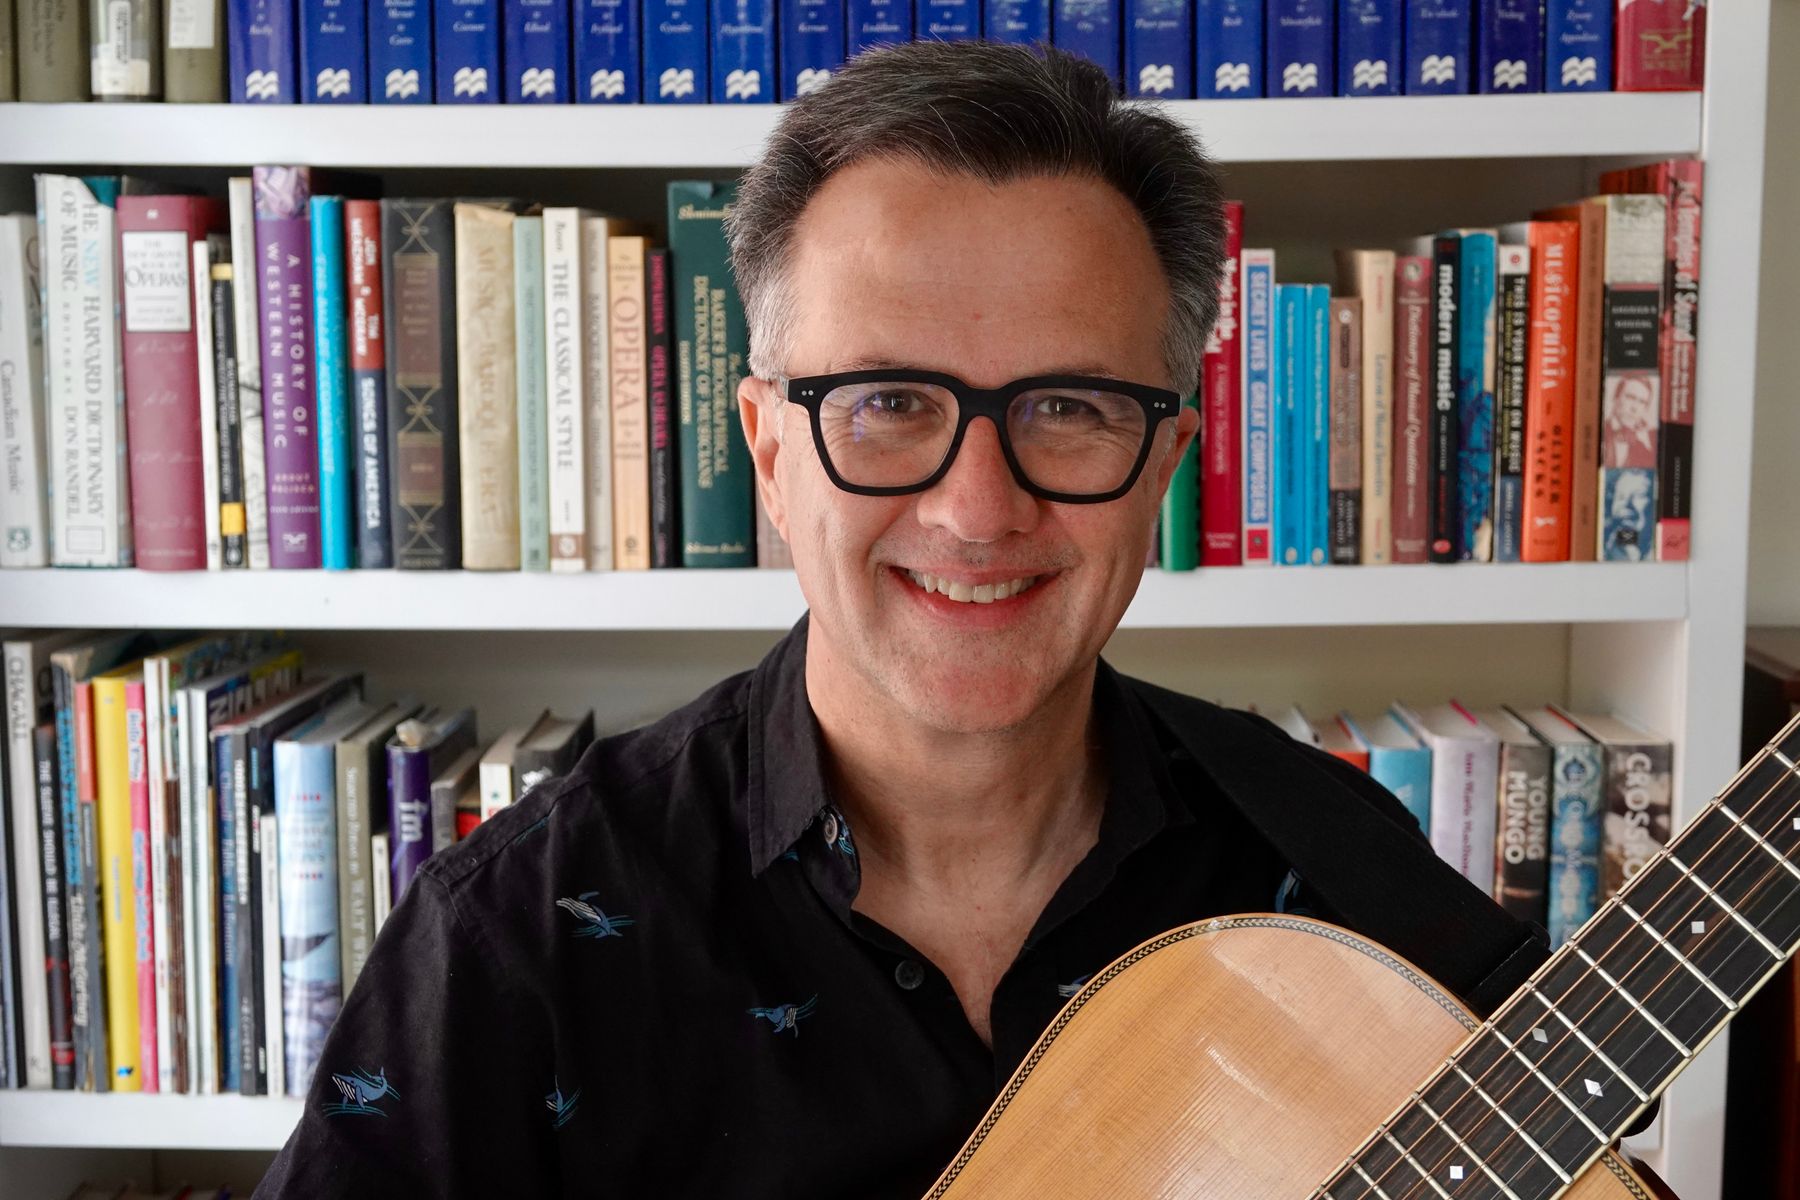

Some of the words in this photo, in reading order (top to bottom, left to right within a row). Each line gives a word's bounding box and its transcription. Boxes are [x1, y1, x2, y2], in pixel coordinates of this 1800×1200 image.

[60, 190, 77, 219] OF
[61, 224, 79, 291] MUSIC
[82, 239, 100, 289] NEW
[286, 253, 300, 267] A
[1675, 206, 1700, 269] Temples
[125, 266, 187, 288] OPERAS
[266, 242, 284, 356] WESTERN
[551, 259, 570, 300] THE
[1250, 271, 1267, 325] SECRET
[1437, 264, 1457, 344] modern
[1513, 277, 1526, 308] THIS
[1675, 271, 1697, 290] of
[287, 284, 306, 391] HISTORY
[693, 275, 711, 372] DICTIONARY
[1405, 304, 1422, 364] Dictionary
[1512, 311, 1525, 326] IS
[1674, 292, 1698, 342] Sound
[83, 296, 102, 393] HARVARD
[553, 306, 572, 407] CLASSICAL
[613, 296, 640, 410] OPERA
[1250, 329, 1267, 371] LIVES
[1511, 328, 1525, 362] YOUR
[1, 360, 18, 439] Canadian
[695, 375, 712, 398] OF
[1405, 366, 1422, 380] of
[1436, 348, 1456, 410] music
[1510, 366, 1524, 407] BRAIN
[64, 405, 81, 445] DON
[271, 373, 288, 448] MUSIC
[292, 406, 308, 437] OF
[361, 377, 377, 432] SONGS
[712, 358, 729, 476] BIOGRAPHICAL
[1250, 381, 1267, 427] GREAT
[1406, 381, 1422, 423] Musical
[1509, 409, 1522, 428] ON
[4, 444, 21, 494] Music
[85, 400, 105, 519] DICTIONARY
[363, 433, 378, 456] OF
[556, 415, 574, 471] STYLE
[696, 400, 713, 488] MUSICIANS
[1508, 430, 1522, 472] MUSIC
[65, 448, 83, 520] RANDEL
[364, 456, 381, 529] AMERICA
[1250, 430, 1268, 520] COMPOSERS
[8, 657, 27, 742] CHAGALL
[40, 760, 51, 783] THE
[1505, 771, 1528, 864] MUNGO
[1526, 776, 1546, 860] YOUNG
[1622, 752, 1652, 880] CROSSRO
[43, 829, 57, 875] SHOULD
[46, 879, 58, 894] BE
